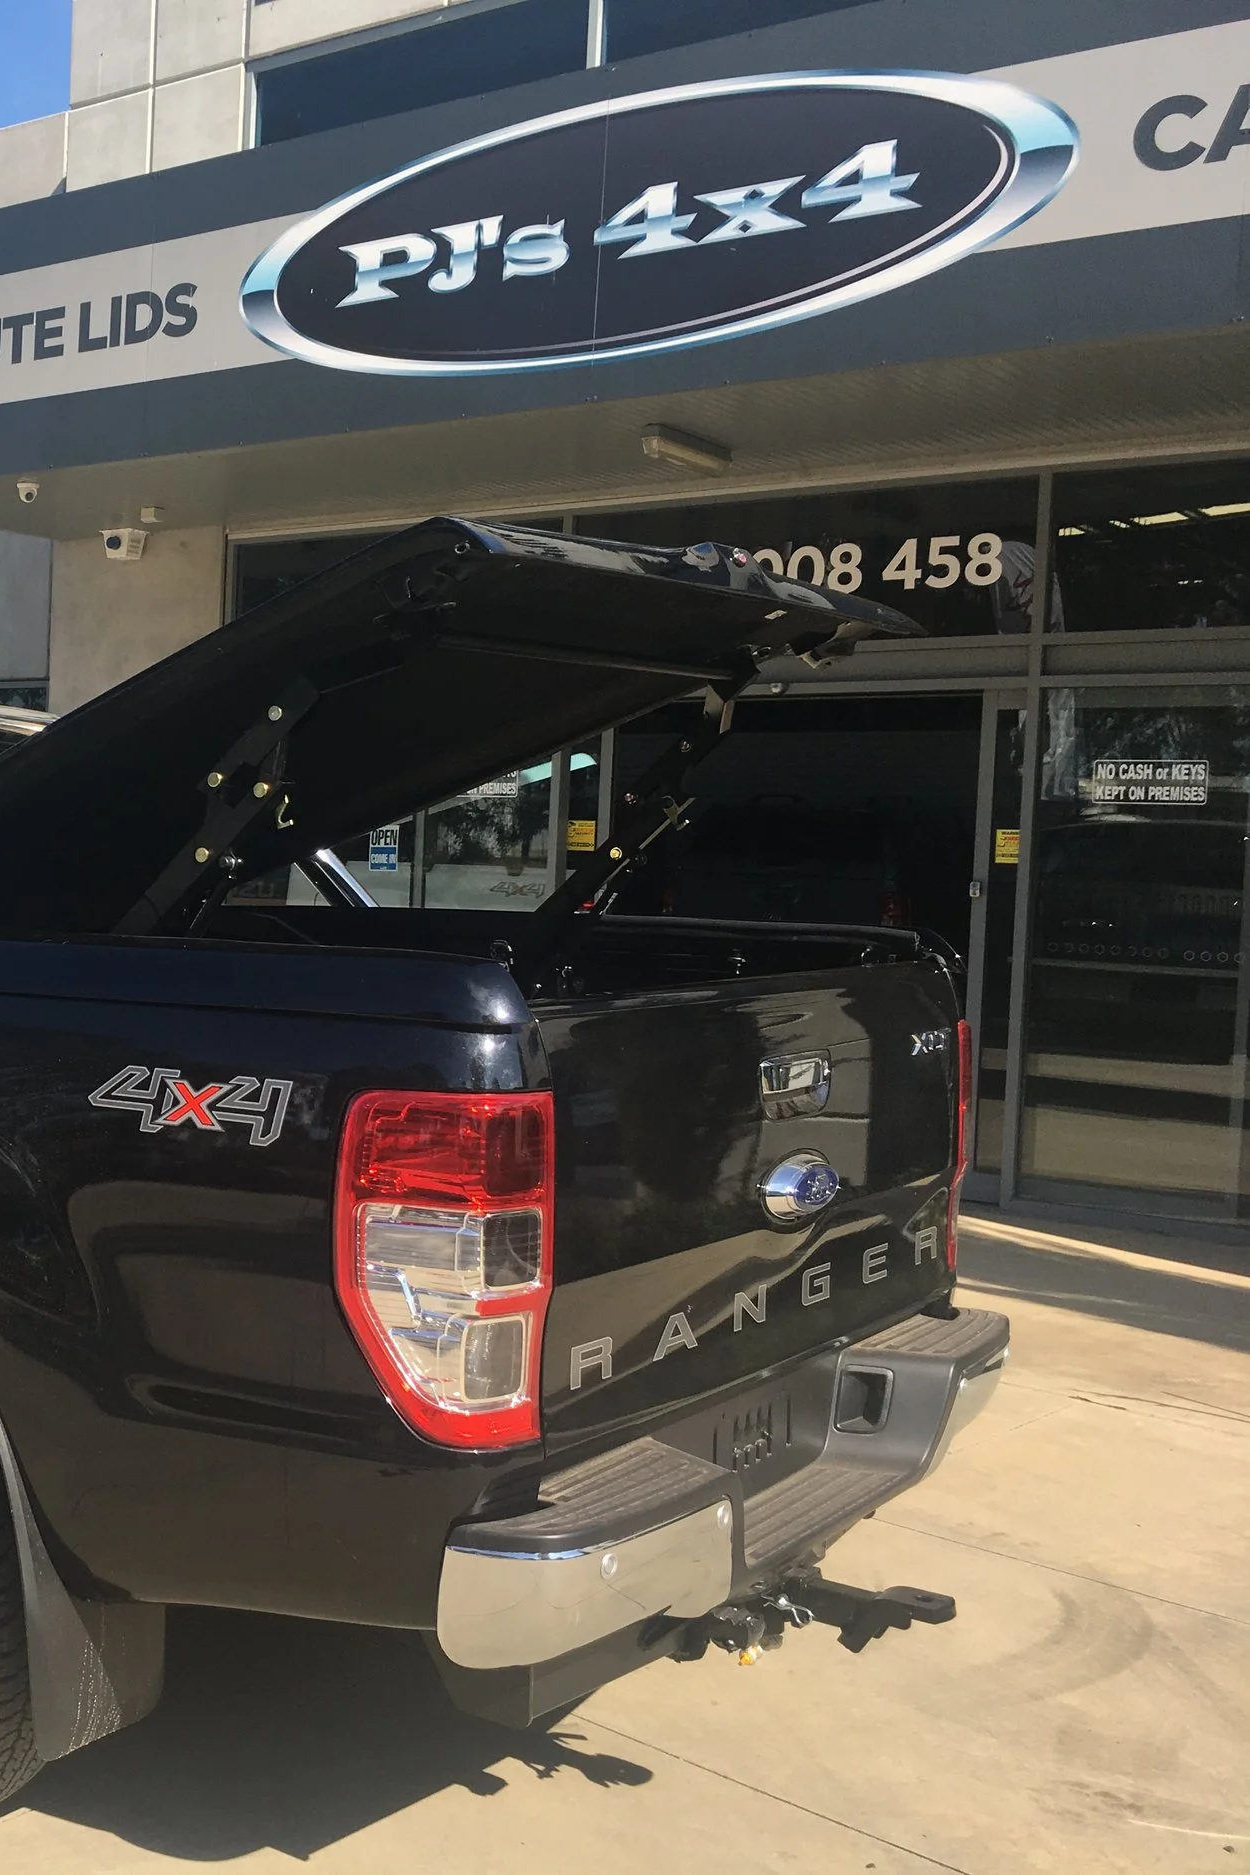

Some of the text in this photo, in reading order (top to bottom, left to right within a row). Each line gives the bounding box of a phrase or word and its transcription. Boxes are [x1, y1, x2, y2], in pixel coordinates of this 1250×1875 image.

[335, 138, 923, 308] PJ's 4x4
[78, 282, 198, 353] LIDS
[881, 532, 1003, 590] 458
[479, 782, 517, 795] PREMISES
[1096, 763, 1206, 780] NO CASH or KEYS
[1095, 786, 1205, 801] KEPT ON PREMISES
[371, 829, 398, 846] OPEN
[569, 1226, 939, 1391] RANGER
